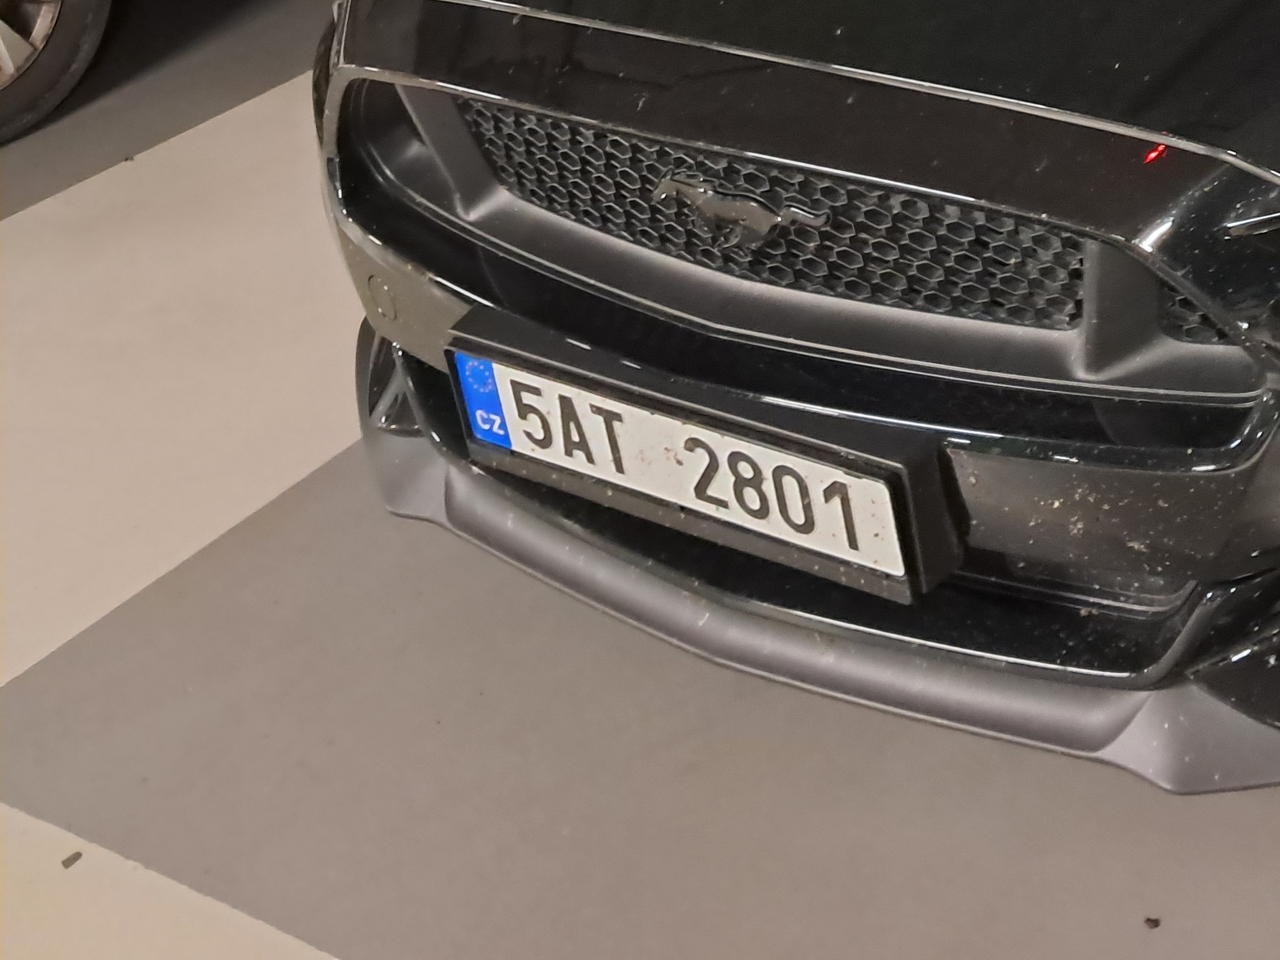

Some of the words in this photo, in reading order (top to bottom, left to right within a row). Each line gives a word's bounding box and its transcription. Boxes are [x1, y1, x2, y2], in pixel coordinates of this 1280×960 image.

[475, 409, 505, 436] CZ
[509, 378, 625, 474] 5AT
[683, 436, 860, 552] 2801
